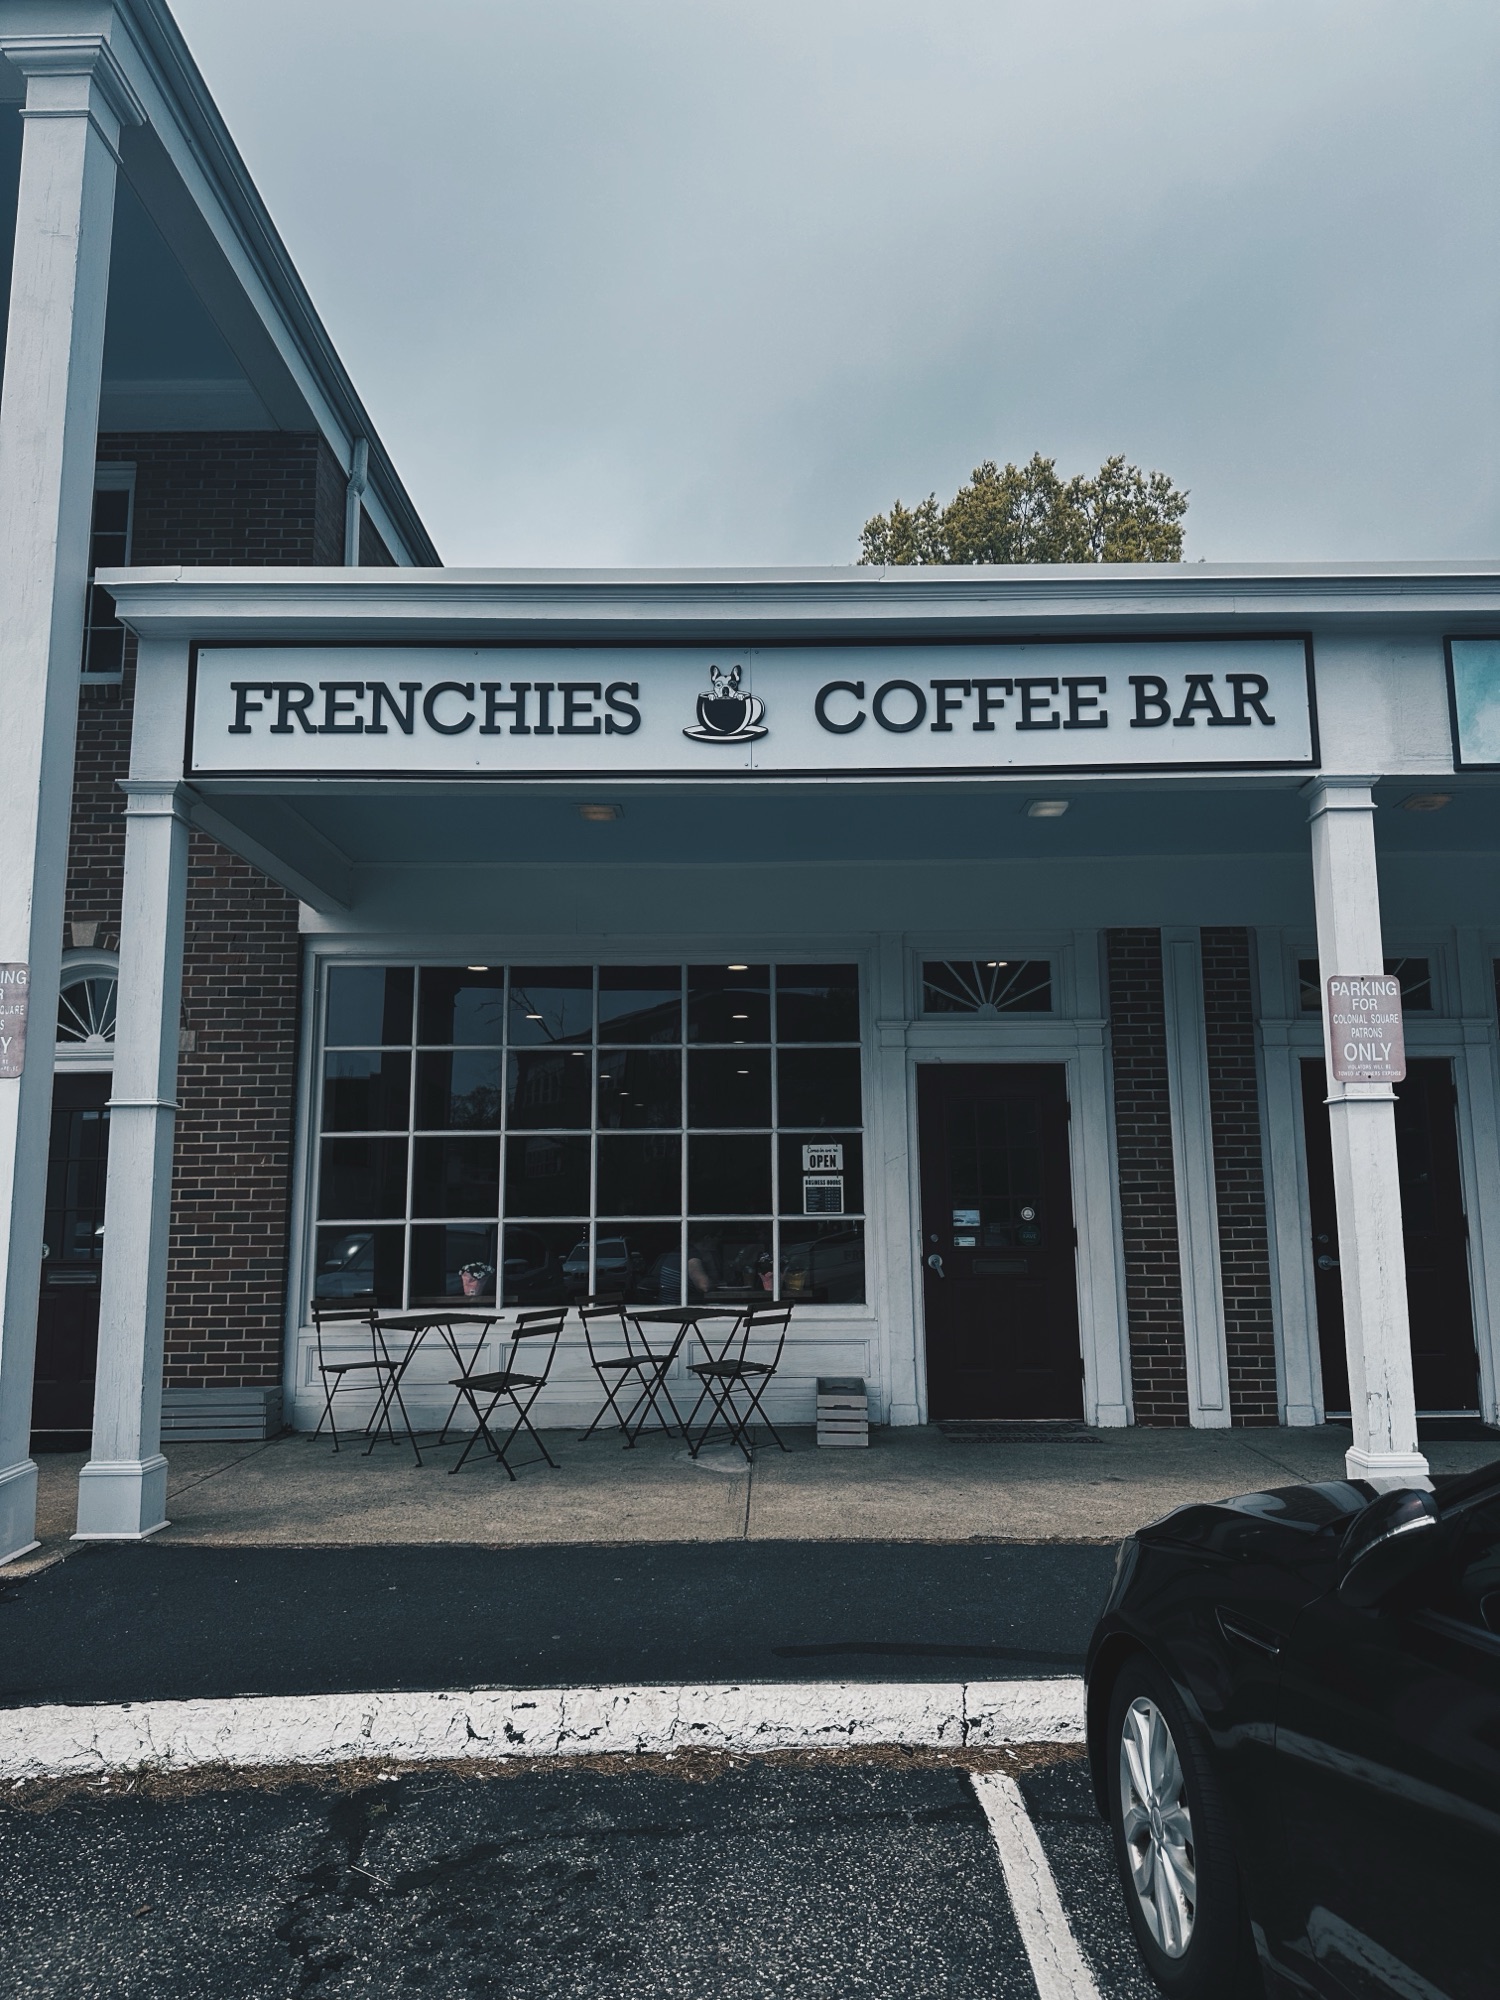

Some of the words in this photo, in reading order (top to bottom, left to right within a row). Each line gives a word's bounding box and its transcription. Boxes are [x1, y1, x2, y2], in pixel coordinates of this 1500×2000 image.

[228, 681, 641, 735] FRENCHIES
[814, 677, 1108, 734] COFFEE
[1128, 674, 1276, 728] BAR
[1331, 981, 1397, 996] PARKING
[0, 1005, 24, 1015] QUARE
[1352, 998, 1378, 1011] FOR
[1333, 1014, 1368, 1024] COLONIAL
[1371, 1014, 1399, 1024] SQUARE
[1351, 1028, 1383, 1038] PATRONS
[1344, 1043, 1392, 1061] ONLY
[810, 1155, 836, 1168] OPEN
